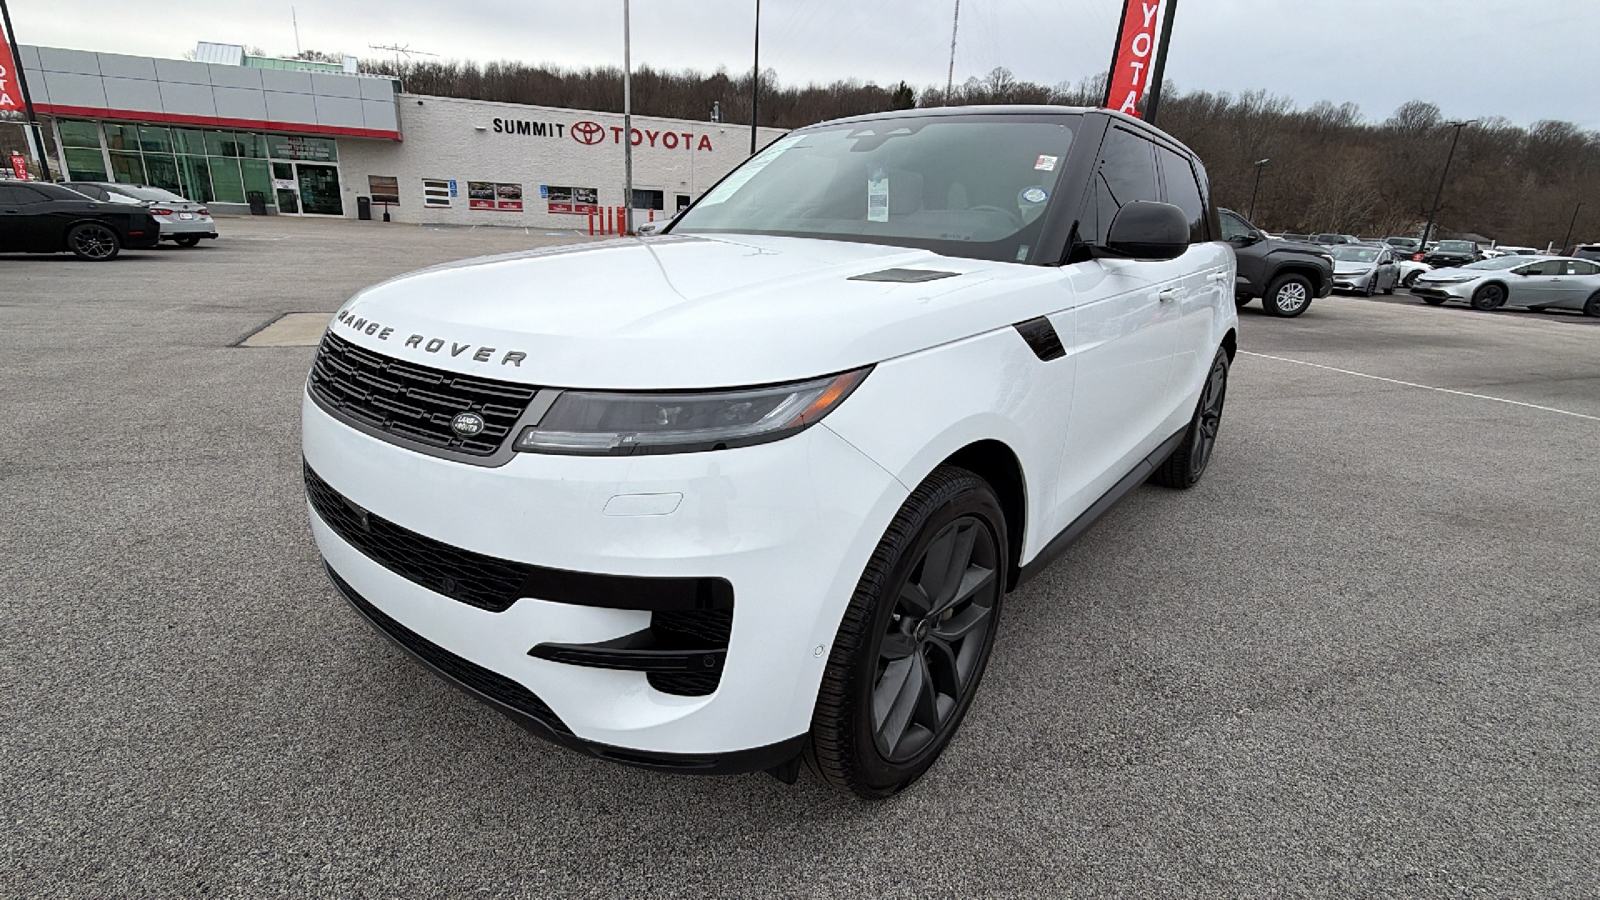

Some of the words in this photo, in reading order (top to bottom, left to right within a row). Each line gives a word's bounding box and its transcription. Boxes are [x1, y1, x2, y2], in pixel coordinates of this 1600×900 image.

[1120, 2, 1158, 114] YOTA
[492, 118, 565, 138] SUMMIT
[610, 126, 713, 151] TOYOTA
[337, 310, 394, 341] RANGE
[404, 333, 527, 367] ROVER
